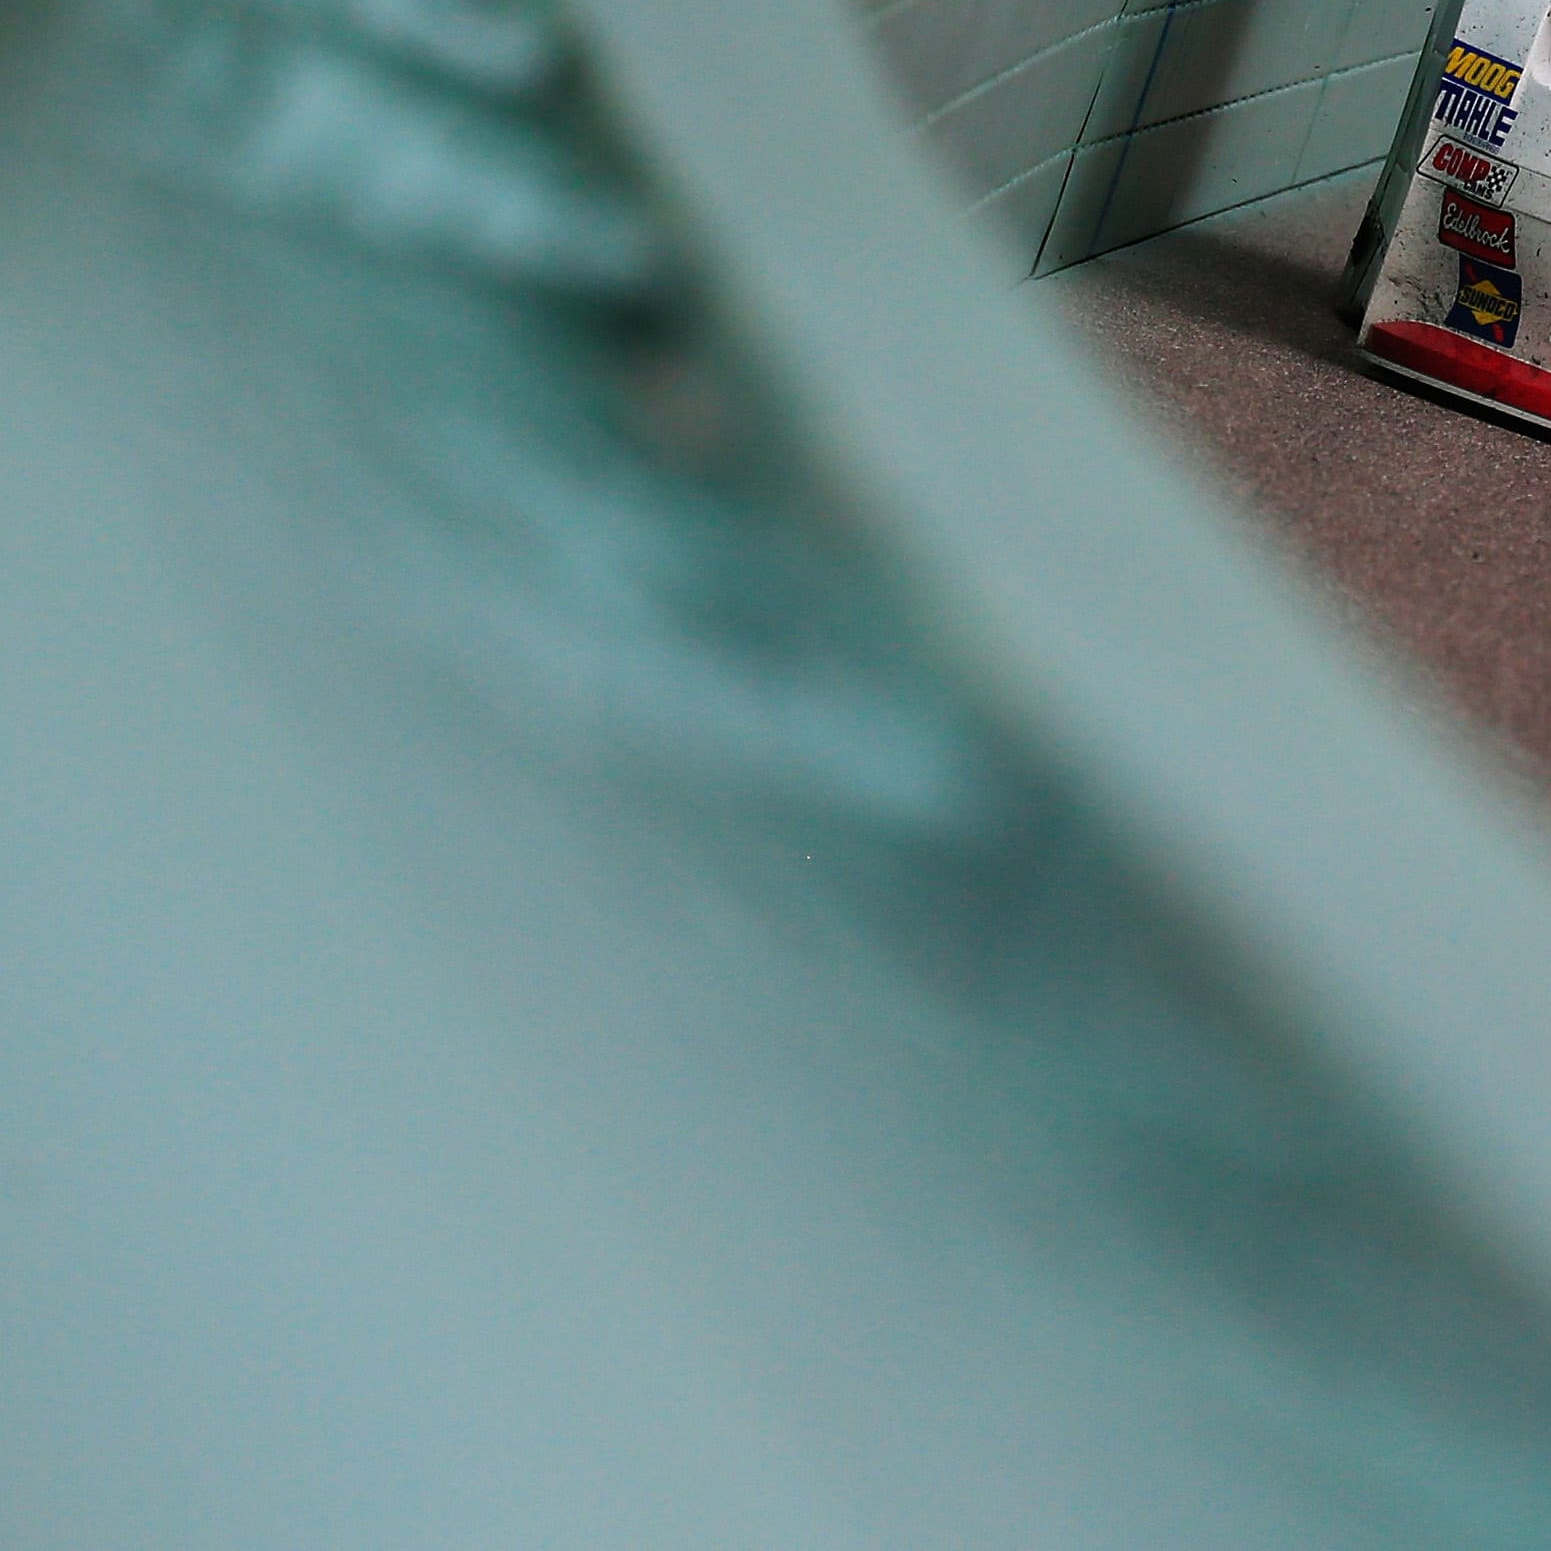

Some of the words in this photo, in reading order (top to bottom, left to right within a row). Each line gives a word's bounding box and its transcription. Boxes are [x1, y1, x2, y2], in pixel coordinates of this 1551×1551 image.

[1445, 46, 1521, 99] MOOG
[1434, 79, 1519, 148] MAHLE
[1433, 143, 1491, 185] COMP
[1443, 203, 1510, 254] Edelbrock
[1459, 286, 1517, 320] SUNOCO
